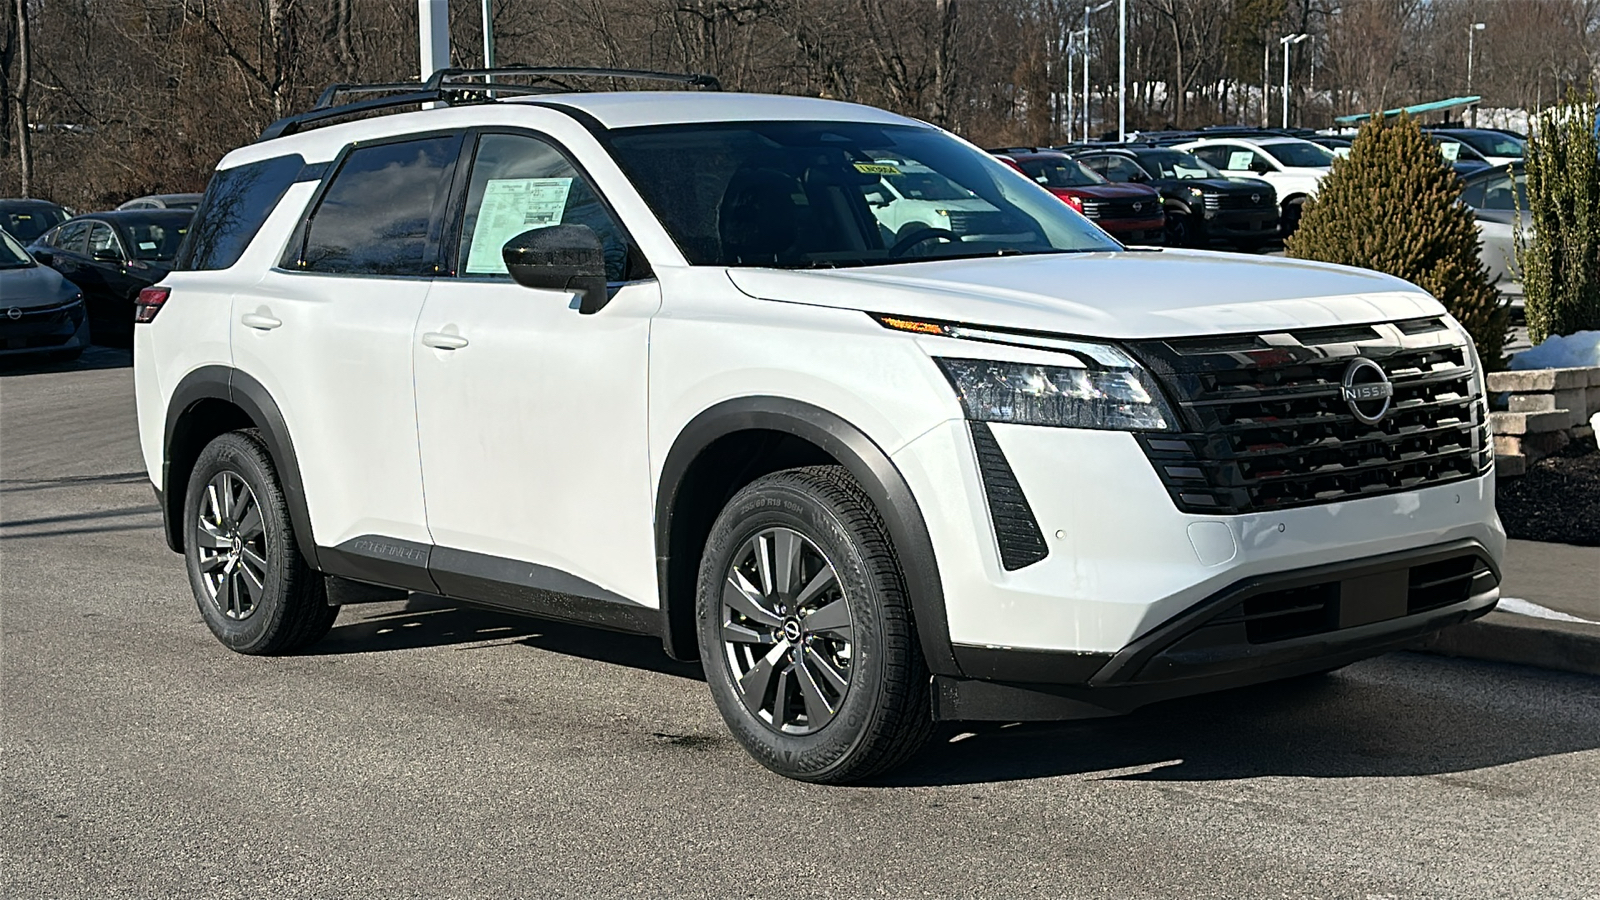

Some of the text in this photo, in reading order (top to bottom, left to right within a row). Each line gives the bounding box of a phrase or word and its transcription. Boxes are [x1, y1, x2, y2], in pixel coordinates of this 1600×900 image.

[1345, 385, 1392, 399] NISSAN
[766, 498, 781, 507] R18
[354, 540, 427, 560] PATHFINDER
